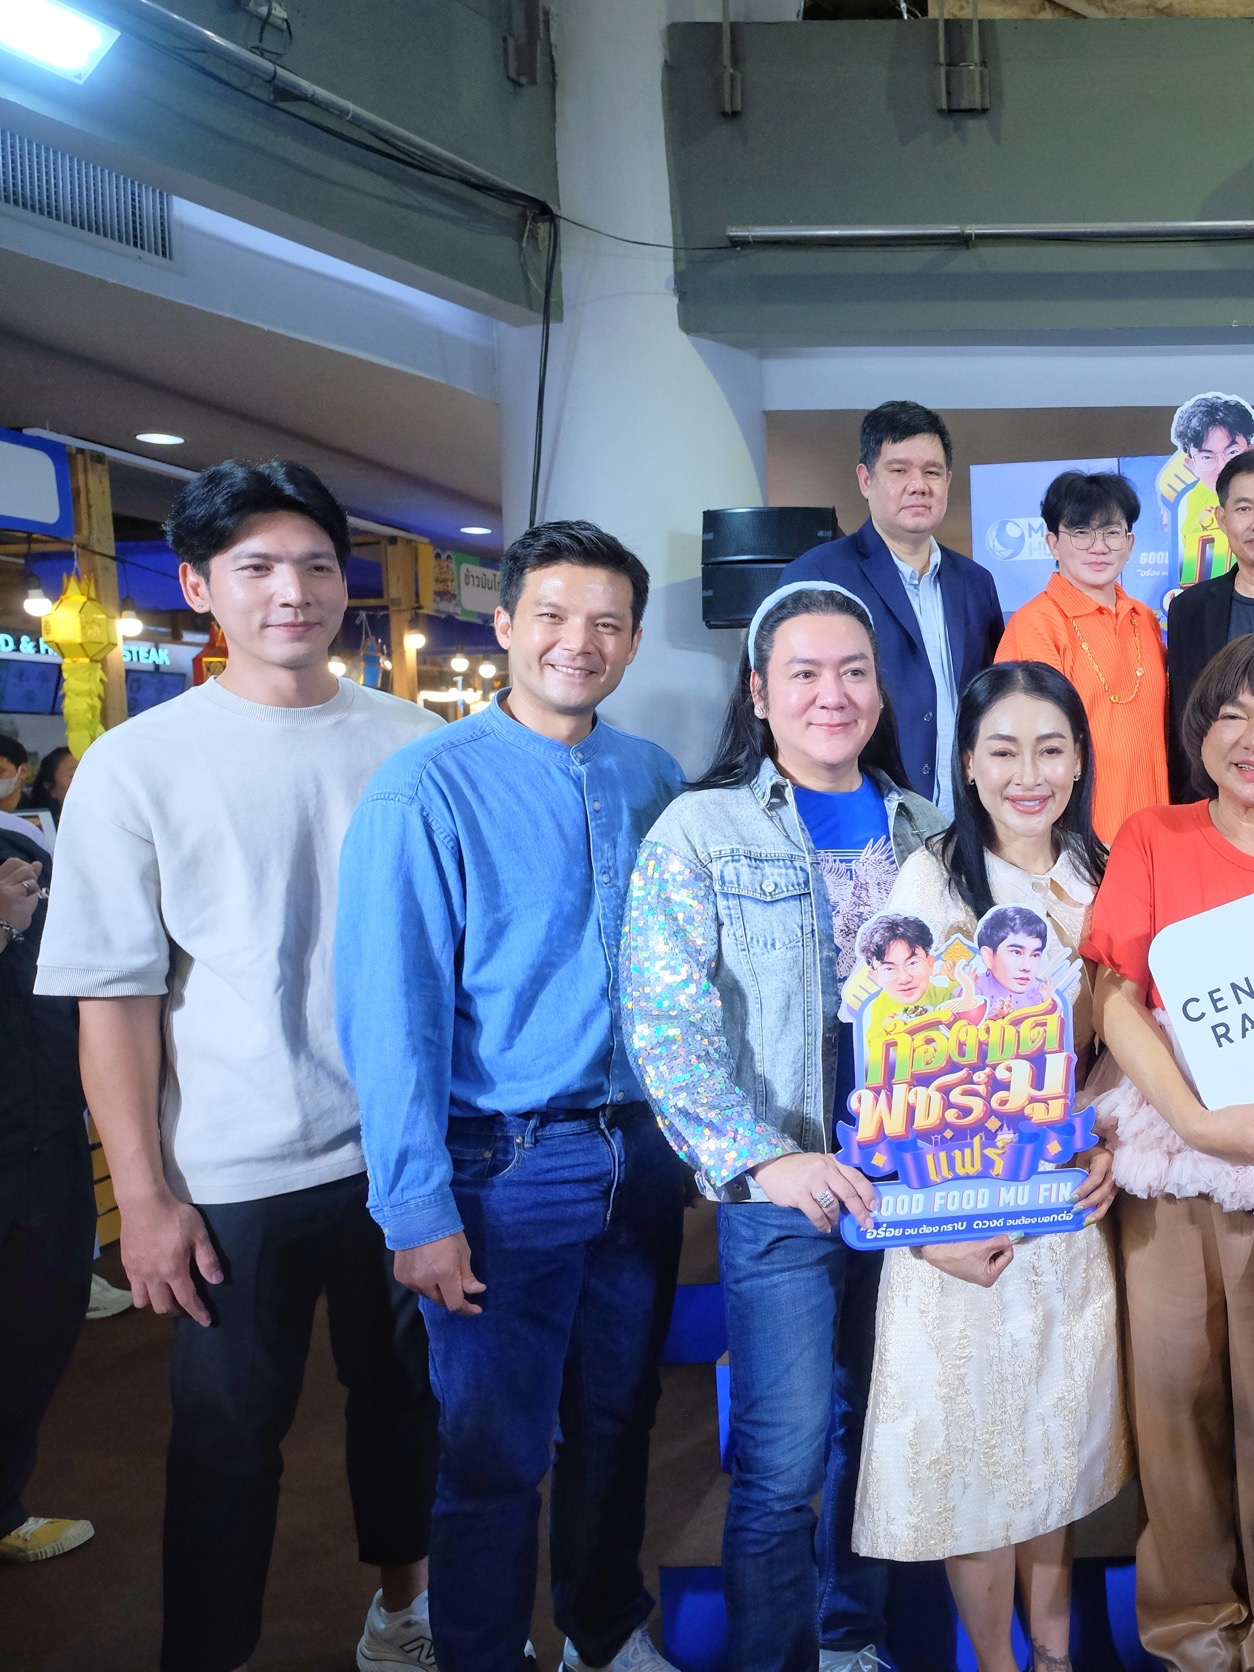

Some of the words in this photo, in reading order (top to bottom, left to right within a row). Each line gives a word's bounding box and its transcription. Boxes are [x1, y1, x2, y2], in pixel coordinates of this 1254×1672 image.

[464, 567, 499, 592] ข้าวมันไ
[873, 1193, 924, 1217] OOD
[934, 1188, 989, 1212] FOOD
[999, 1185, 1029, 1207] MU
[1038, 1181, 1072, 1204] FIN
